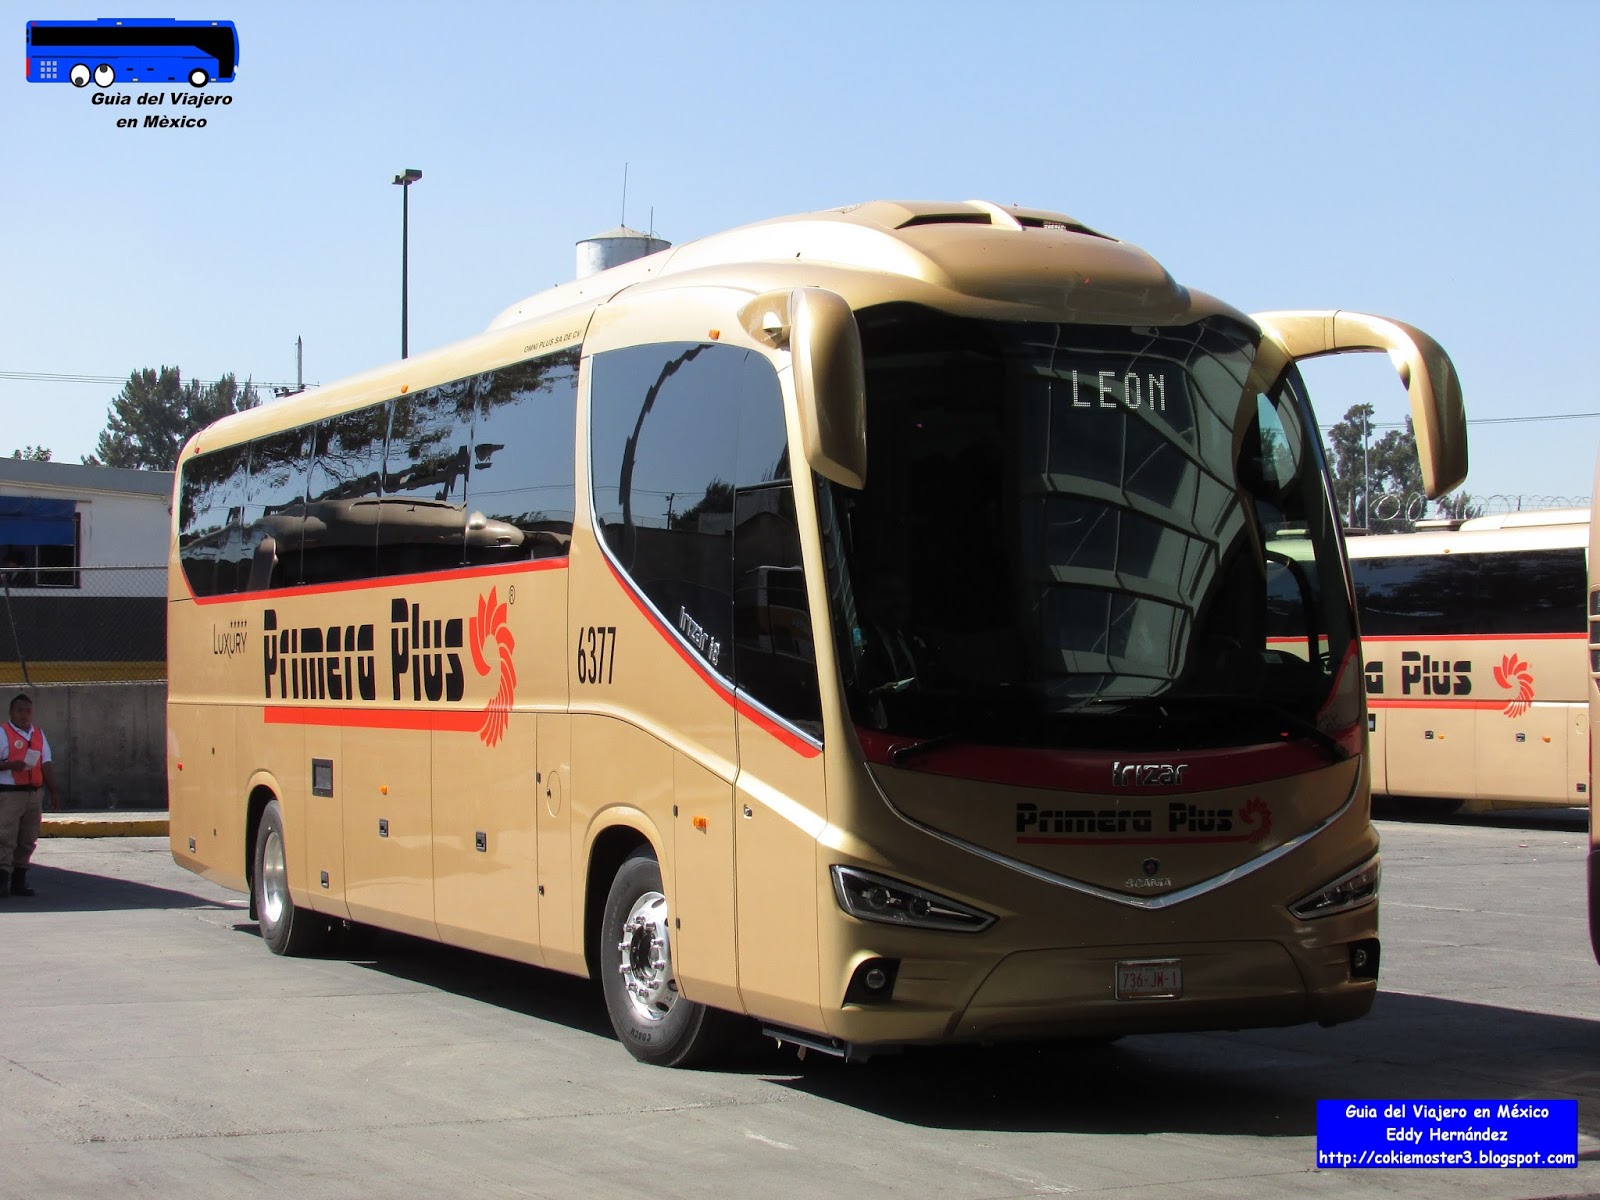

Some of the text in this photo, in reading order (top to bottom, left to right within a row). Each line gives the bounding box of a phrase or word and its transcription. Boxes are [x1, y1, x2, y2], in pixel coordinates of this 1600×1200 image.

[523, 329, 582, 353] OMNI PLUS SA DE CV
[1072, 370, 1165, 410] LEON
[263, 598, 465, 701] Primera Plus
[577, 626, 617, 685] 6377
[1401, 651, 1472, 695] Plus
[1016, 803, 1233, 833] Primera Plus
[1125, 877, 1172, 888] SCANIA
